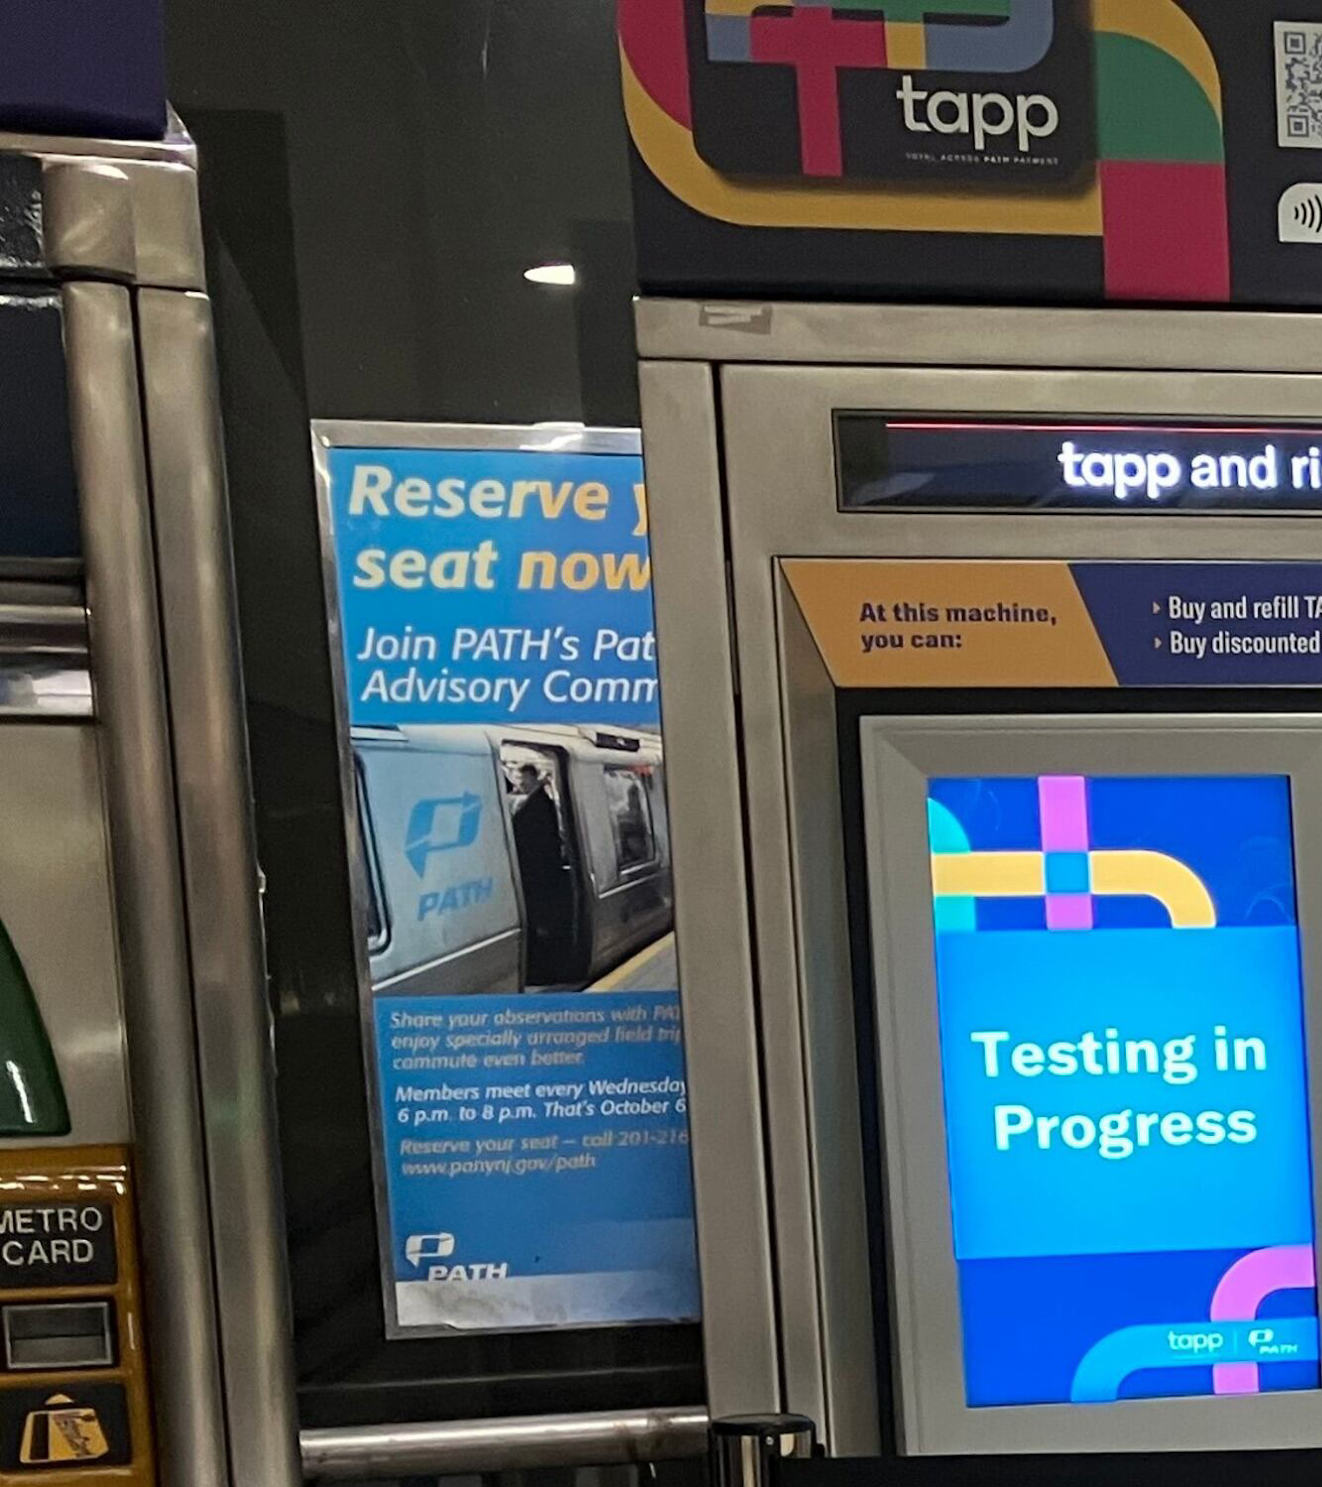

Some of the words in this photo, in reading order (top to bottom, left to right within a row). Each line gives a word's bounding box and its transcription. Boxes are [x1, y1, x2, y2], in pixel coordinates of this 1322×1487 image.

[896, 75, 1058, 151] tapp
[1059, 442, 1180, 500] tapp
[1190, 445, 1277, 489] and
[349, 466, 609, 520] Reserve
[354, 540, 498, 589] seat
[860, 603, 886, 622] At
[893, 603, 939, 622] this
[946, 603, 1056, 625] machine,
[1169, 596, 1205, 624] Buy
[1211, 596, 1246, 618] and
[1254, 596, 1298, 618] refill
[357, 626, 436, 660] Join
[453, 627, 579, 660] PATH's
[593, 629, 656, 661] Pat
[862, 635, 903, 653] you
[911, 635, 961, 648] can:
[1171, 631, 1206, 658] Buy
[1213, 631, 1320, 653] discounted
[361, 667, 530, 712] Advisory
[418, 879, 493, 921] PATH
[391, 1012, 443, 1028] Share
[449, 1014, 488, 1030] your
[494, 1008, 604, 1026] observations
[611, 1005, 647, 1021] with
[392, 1036, 440, 1054] enjoy
[446, 1030, 521, 1050] specially
[527, 1027, 609, 1047] arranged
[615, 1026, 653, 1043] field
[393, 1054, 477, 1069] commute
[484, 1054, 525, 1067] even
[971, 1027, 1197, 1084] Testing
[1214, 1026, 1267, 1071] in
[396, 1084, 479, 1101] Members
[485, 1084, 530, 1098] meet
[536, 1084, 583, 1099] every
[398, 1108, 409, 1122] 6
[460, 1107, 476, 1120] to
[482, 1105, 494, 1119] 8
[499, 1106, 536, 1123] p.m.
[544, 1100, 594, 1117] That's
[601, 1098, 669, 1115] October
[401, 1140, 470, 1155] Reserve
[476, 1139, 514, 1156] your
[521, 1136, 558, 1150] seat
[582, 1130, 613, 1147] call
[994, 1105, 1256, 1159] Progress
[402, 1153, 595, 1177] www.panynj.gov/path
[3, 1239, 93, 1265] CARD
[428, 1262, 508, 1281] PATH
[1168, 1330, 1223, 1353] tapp
